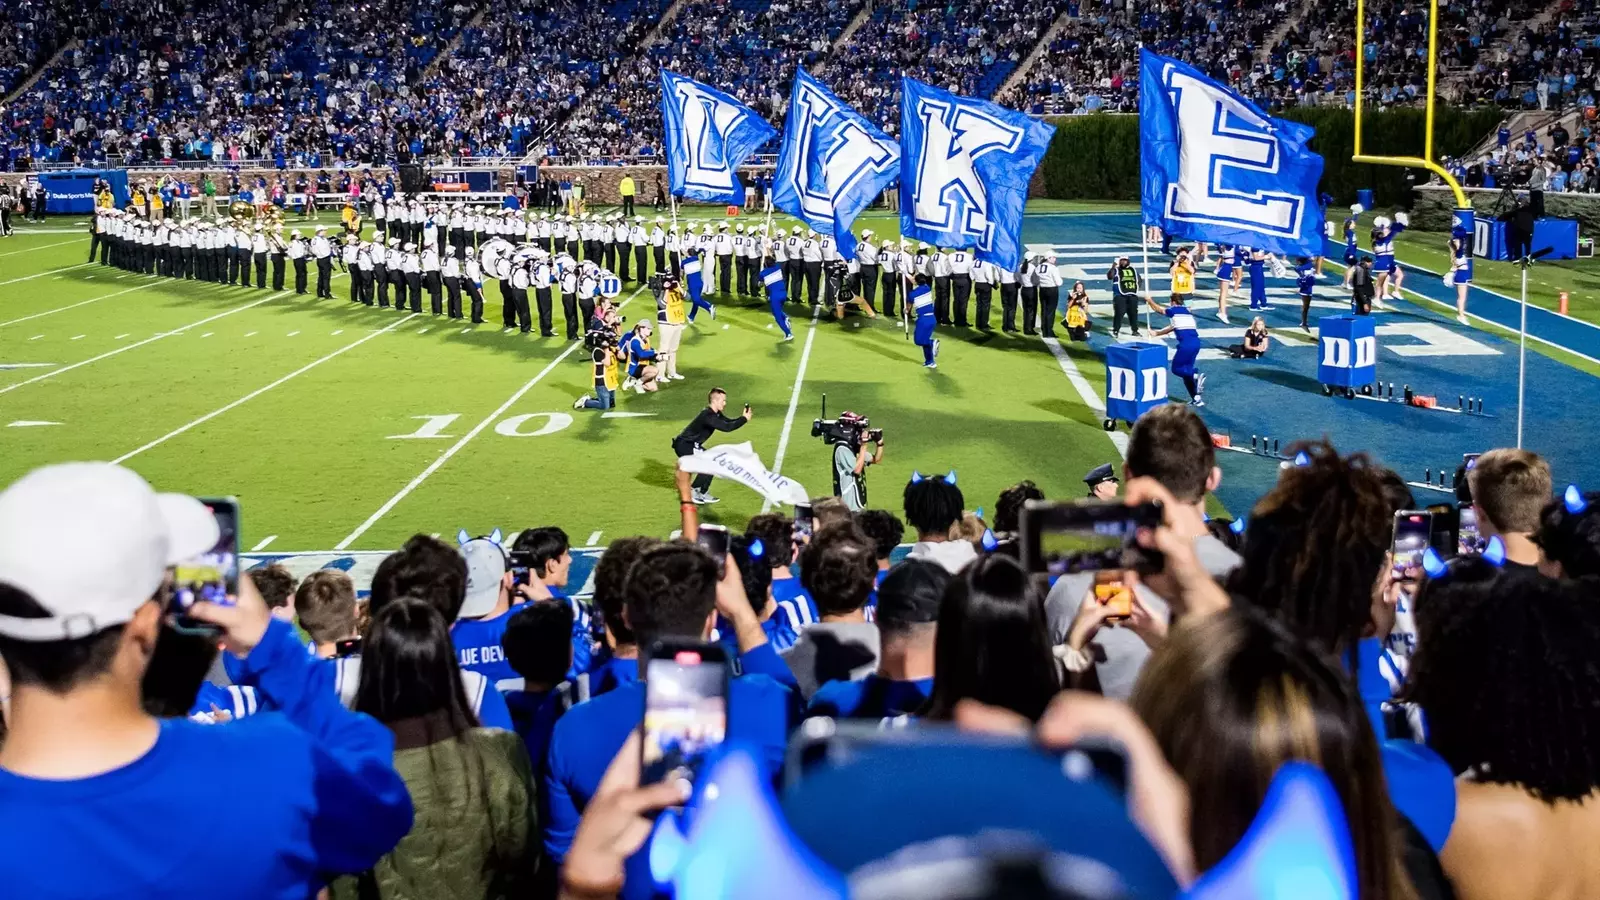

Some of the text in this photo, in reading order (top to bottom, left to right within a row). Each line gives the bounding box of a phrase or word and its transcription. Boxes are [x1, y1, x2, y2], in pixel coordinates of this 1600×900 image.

[790, 79, 899, 224] U
[912, 96, 1024, 252] K
[1161, 63, 1306, 240] E
[1322, 336, 1351, 369] D
[1355, 336, 1376, 369] D
[1108, 366, 1136, 401] D
[1141, 367, 1168, 402] D
